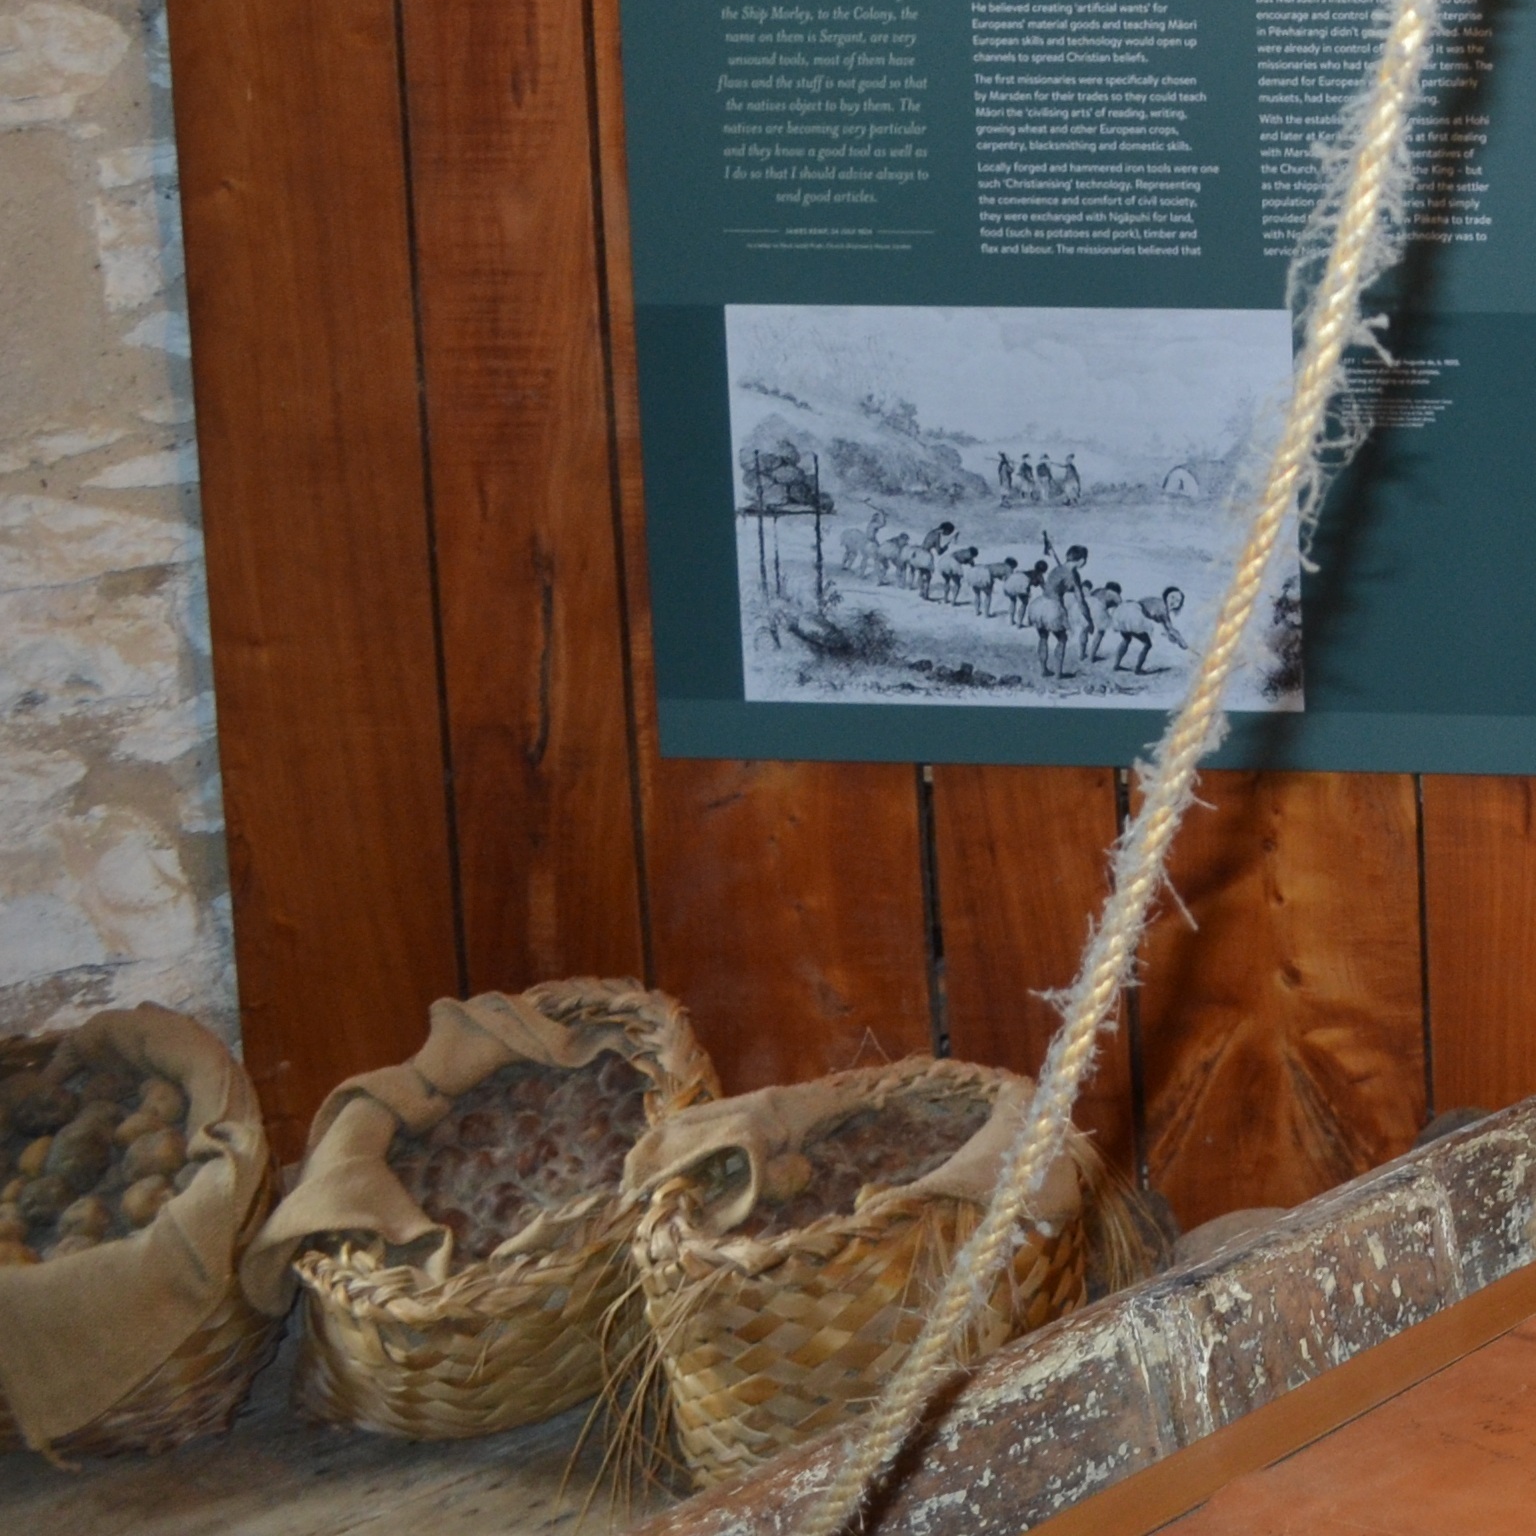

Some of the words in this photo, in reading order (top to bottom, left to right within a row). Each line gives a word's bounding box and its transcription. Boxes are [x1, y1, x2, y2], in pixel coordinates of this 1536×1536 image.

[1256, 12, 1309, 22] encourage
[1312, 11, 1330, 20] and
[1332, 12, 1367, 20] control
[972, 35, 1019, 47] European
[1022, 36, 1044, 45] skills
[1047, 37, 1065, 45] and
[1067, 37, 1122, 48] technology
[1125, 37, 1155, 46] would
[1156, 38, 1182, 48] open
[1184, 38, 1198, 49] up
[972, 52, 1016, 62] channels
[1018, 53, 1029, 62] to
[1031, 53, 1064, 64] spread
[1066, 52, 1111, 62] Christian
[1112, 52, 1148, 62] beliefs.
[974, 73, 993, 84] The
[994, 74, 1014, 84] first
[1017, 76, 1076, 85] missionaries
[1078, 77, 1103, 85] were
[1105, 75, 1159, 87] specifically
[1161, 76, 1197, 85] chosen
[975, 126, 1016, 136] growing
[1018, 124, 1047, 134] wheat
[1050, 125, 1068, 134] and
[1070, 125, 1097, 134] other
[1100, 124, 1146, 136] European
[976, 141, 1026, 151] carpentry,
[1029, 141, 1096, 152] blacksmithing
[1099, 141, 1117, 150] and
[1119, 141, 1164, 151] domestic
[1166, 141, 1192, 151] skills.
